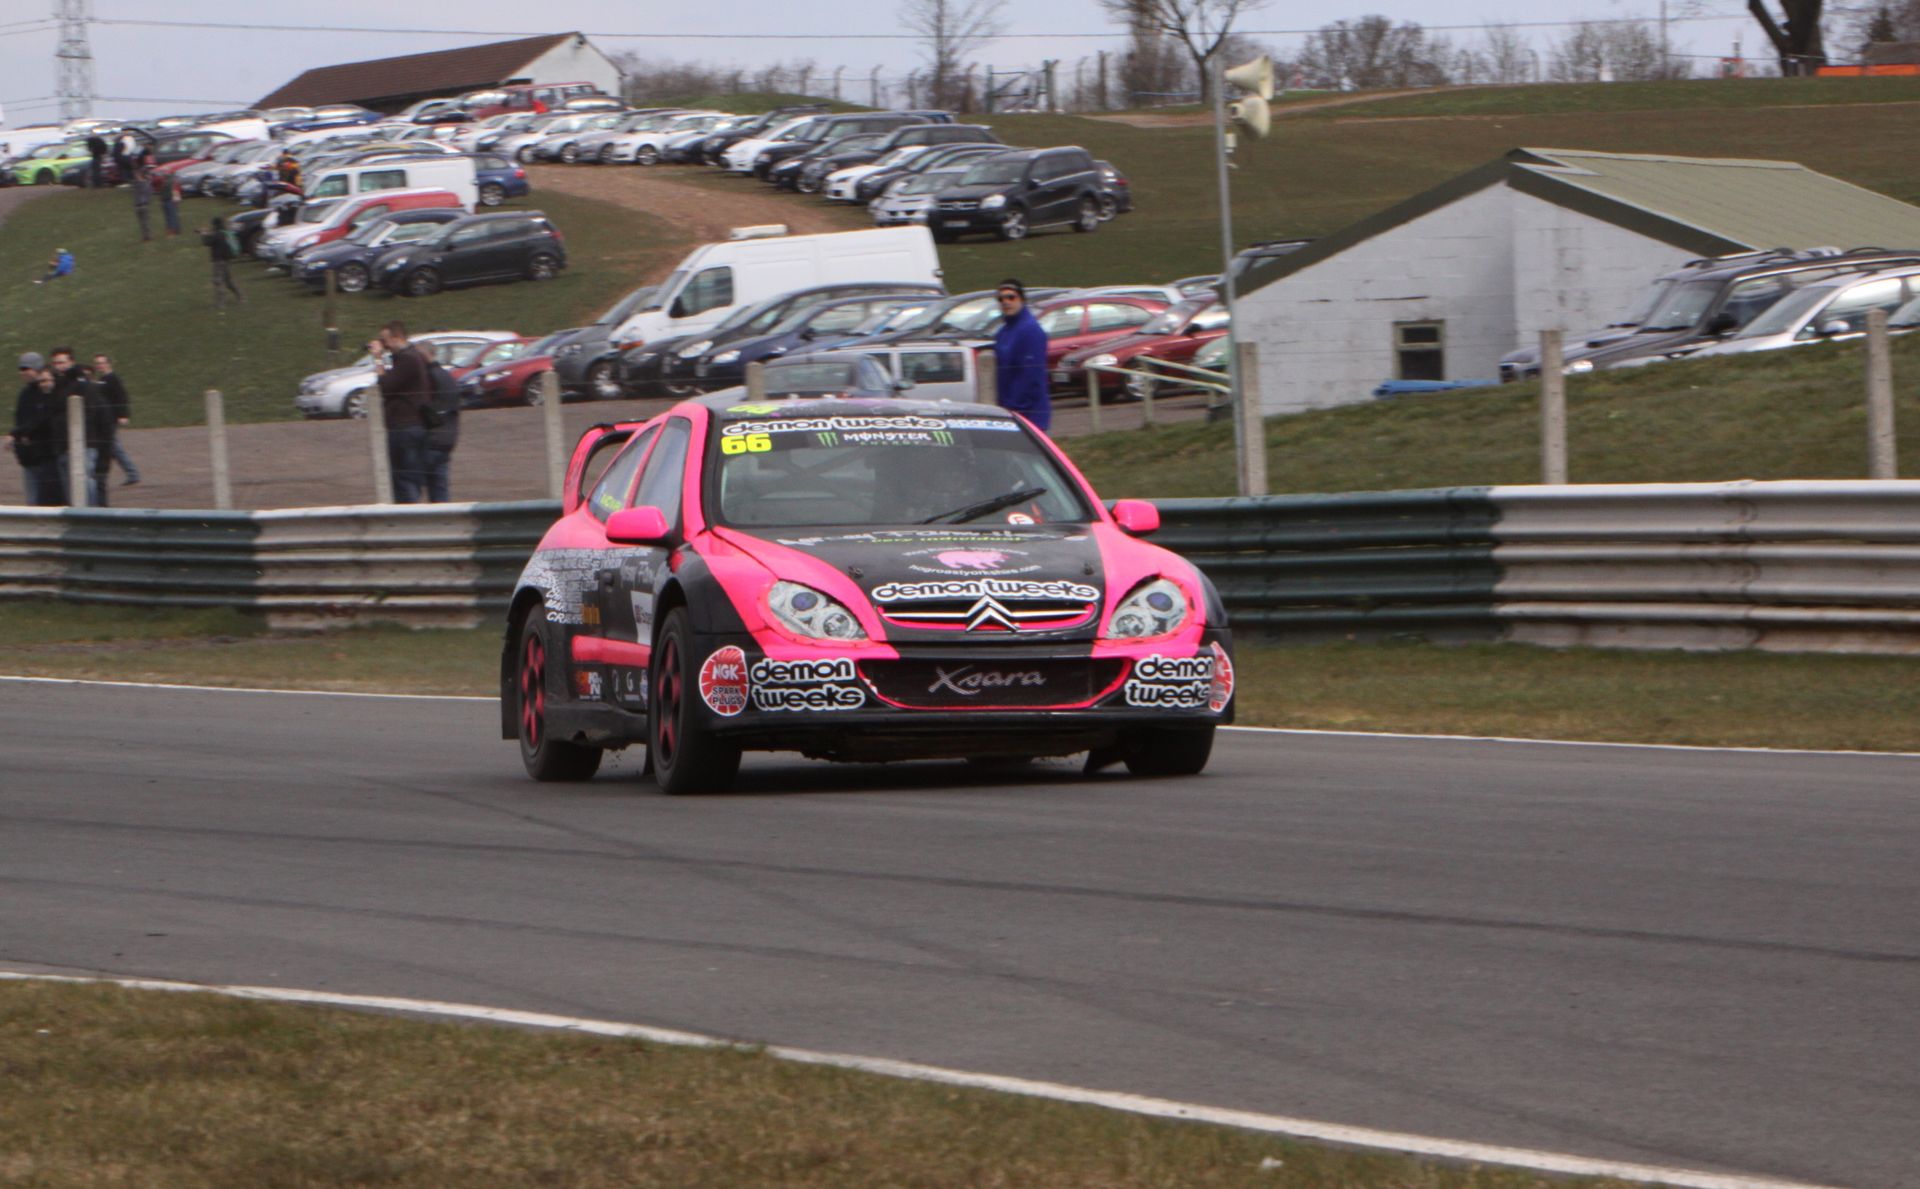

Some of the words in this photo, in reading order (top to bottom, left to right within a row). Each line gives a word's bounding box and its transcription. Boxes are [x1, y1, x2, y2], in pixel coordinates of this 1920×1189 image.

[722, 420, 831, 436] demon
[831, 416, 946, 430] tweeks
[843, 430, 932, 442] MONSTER
[721, 433, 772, 455] 66
[872, 582, 981, 601] demon
[981, 578, 1100, 601] tweeks
[711, 663, 739, 681] NGK
[751, 657, 856, 684] demon
[928, 664, 1047, 695] Xsara
[712, 686, 740, 695] SPARK
[712, 695, 743, 706] PLUGS
[751, 684, 866, 711] tweeks
